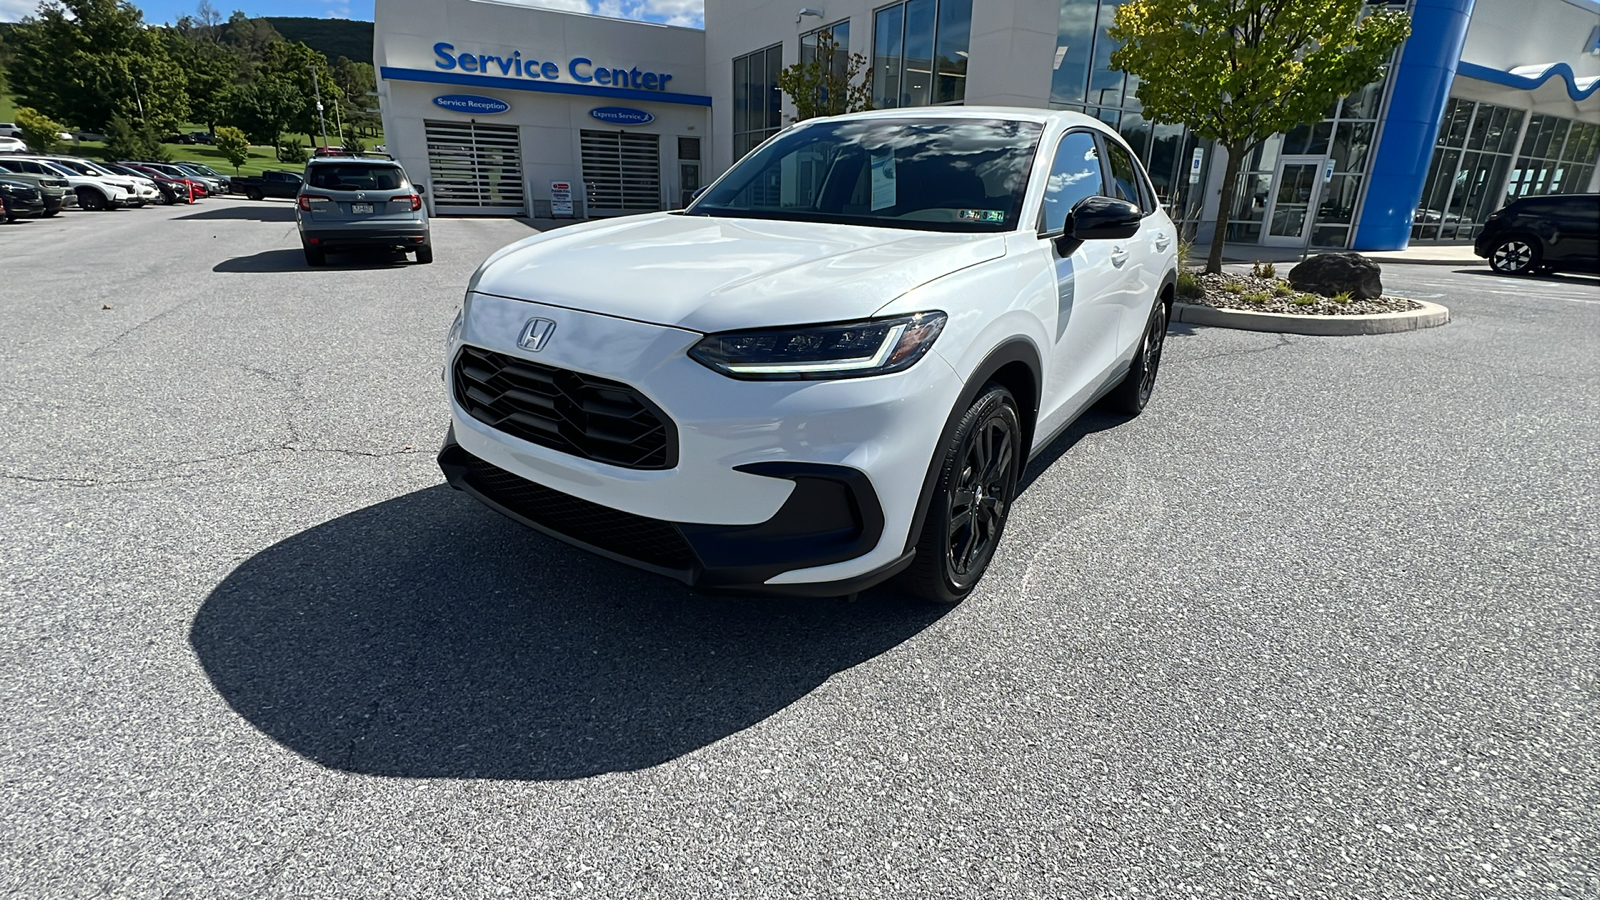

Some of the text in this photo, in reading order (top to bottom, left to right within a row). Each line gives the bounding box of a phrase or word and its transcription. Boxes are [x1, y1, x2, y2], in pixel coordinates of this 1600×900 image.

[433, 42, 672, 91] Service Center
[437, 98, 506, 110] Service Reception
[592, 111, 642, 120] Express Service
